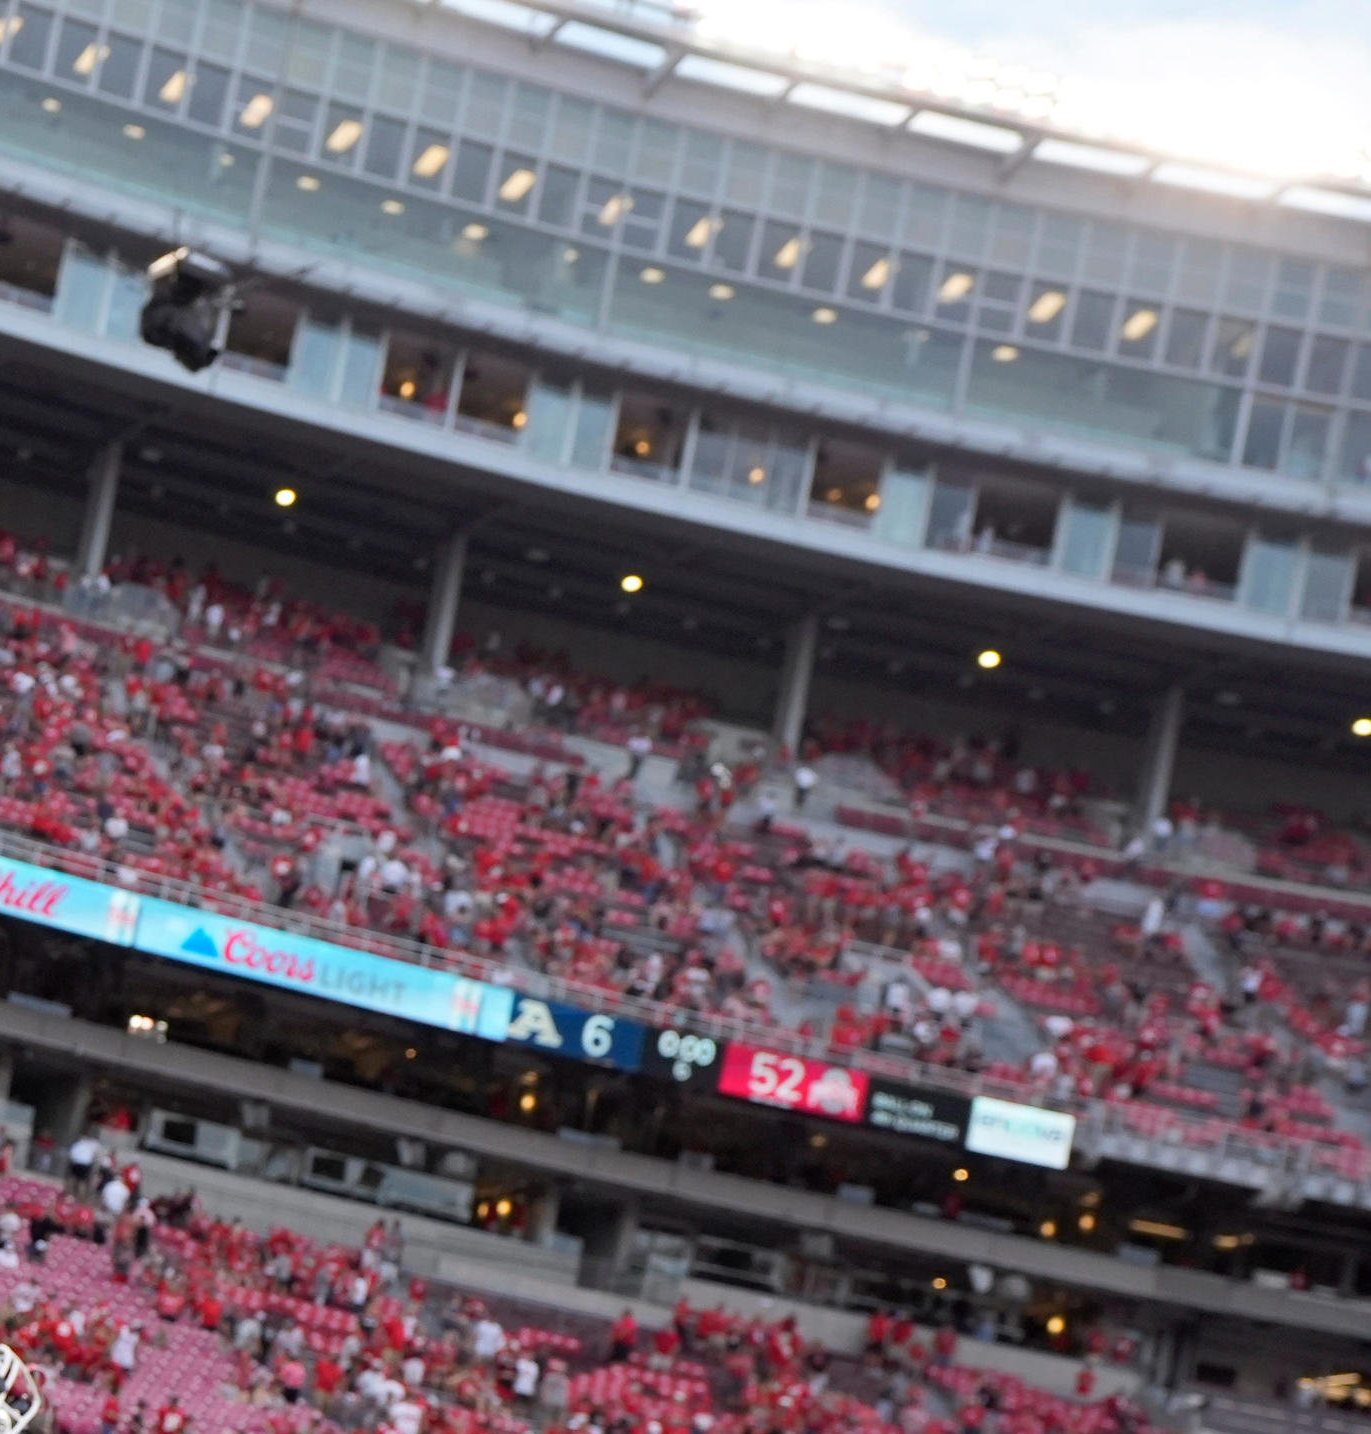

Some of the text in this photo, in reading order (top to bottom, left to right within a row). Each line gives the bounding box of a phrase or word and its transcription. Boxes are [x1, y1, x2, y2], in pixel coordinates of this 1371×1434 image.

[223, 927, 406, 1004] Coors LIGHT
[581, 1014, 616, 1058] 6
[748, 1051, 806, 1103] 52
